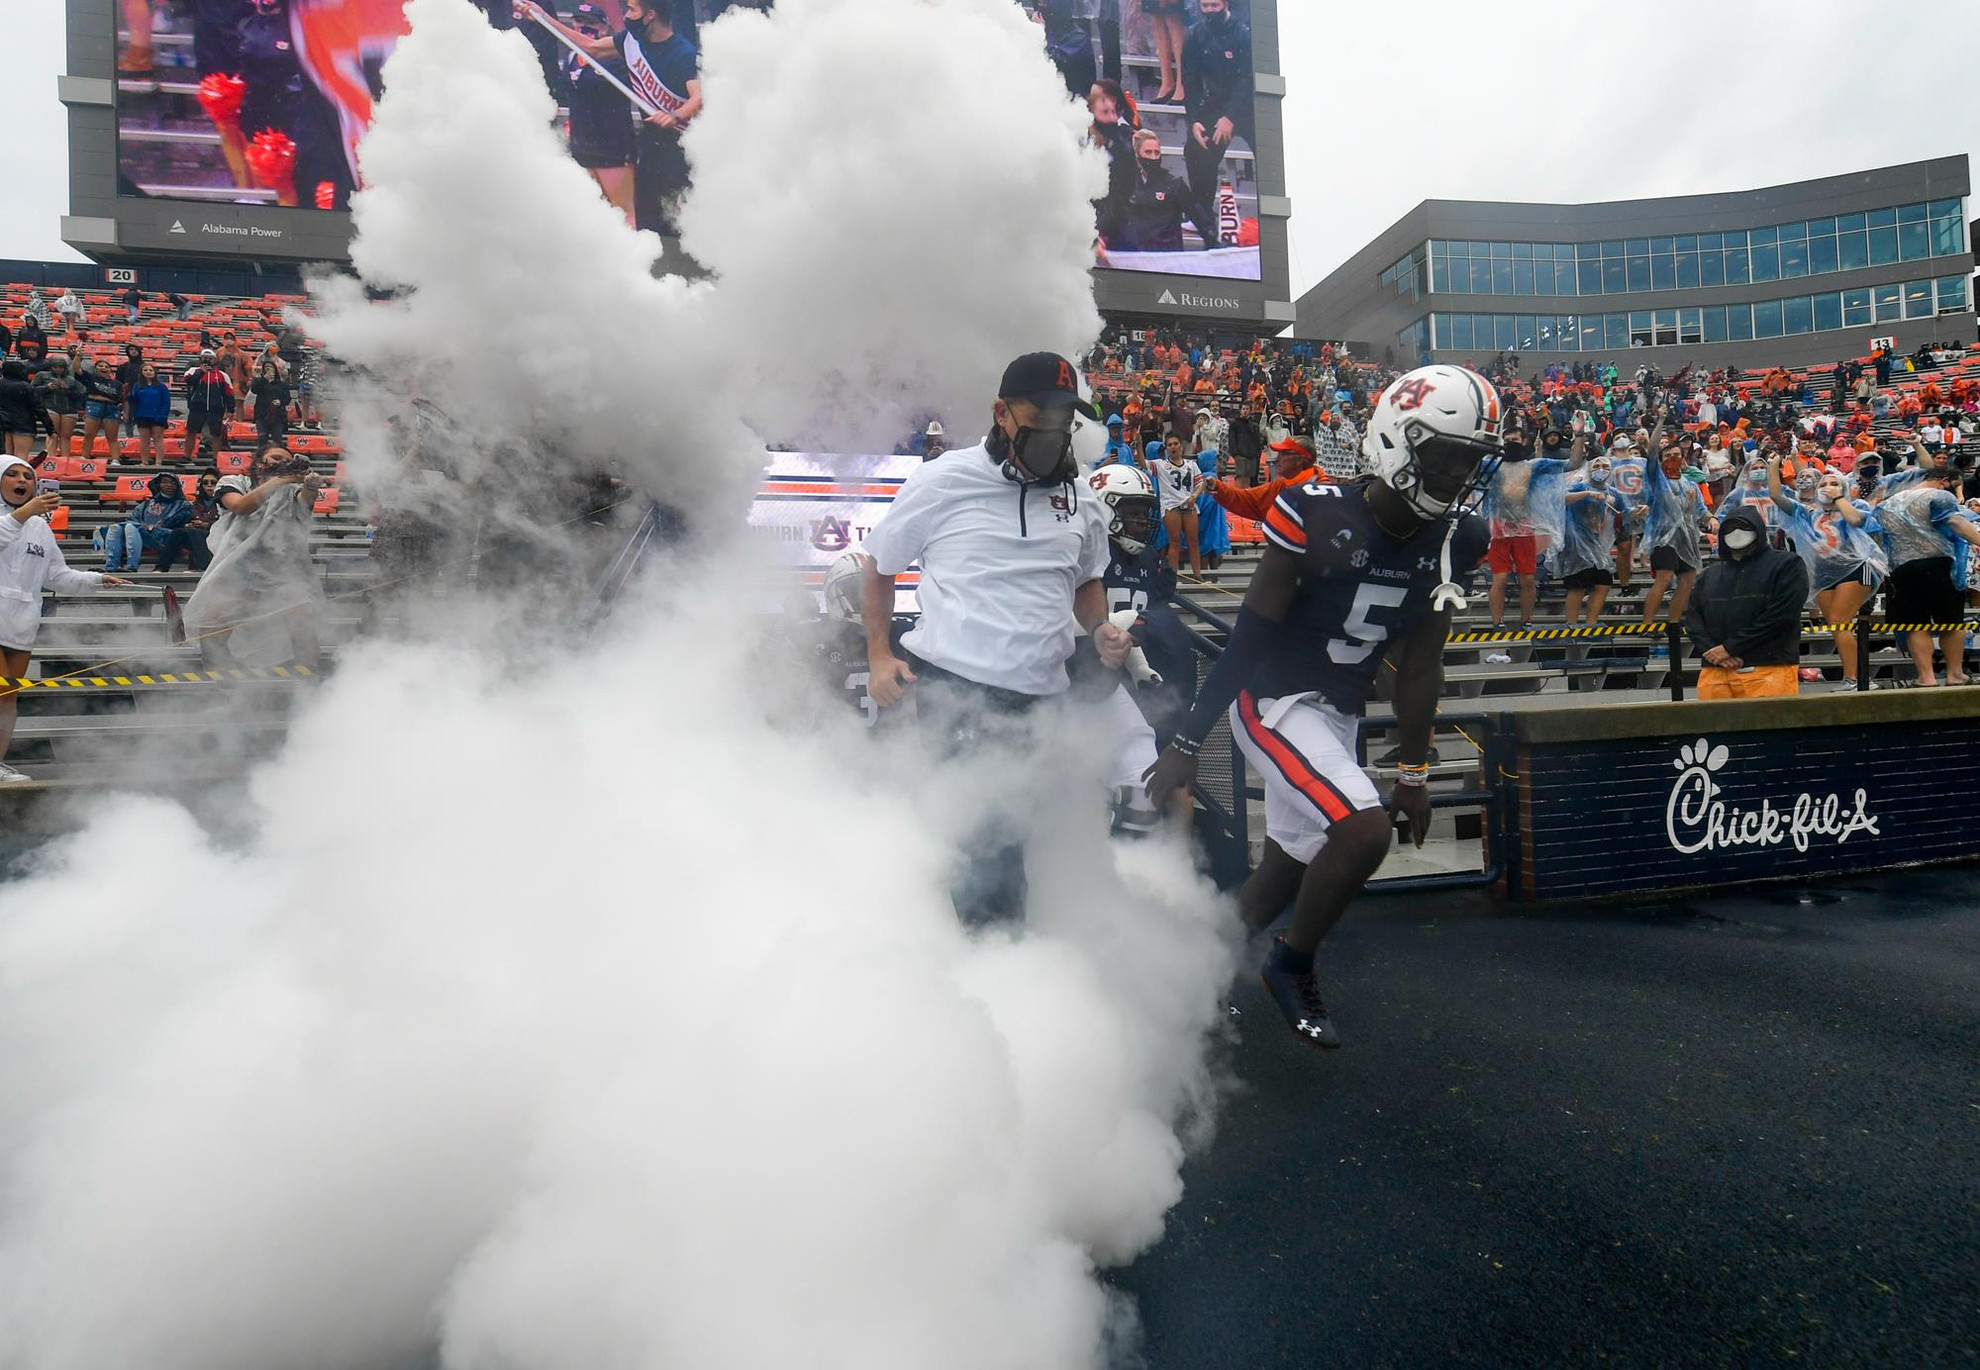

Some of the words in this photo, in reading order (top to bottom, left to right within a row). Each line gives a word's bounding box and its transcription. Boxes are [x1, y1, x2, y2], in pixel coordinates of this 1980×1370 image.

[201, 223, 248, 236] Alabama
[250, 226, 282, 238] Power
[112, 270, 131, 281] 20
[1180, 293, 1239, 309] REGIONS
[1874, 338, 1890, 350] 13
[1169, 469, 1193, 492] 34
[1614, 464, 1644, 496] G
[1368, 567, 1411, 580] AUBURN
[1327, 582, 1409, 664] 5
[1667, 764, 1881, 854] Chick-fil-A
